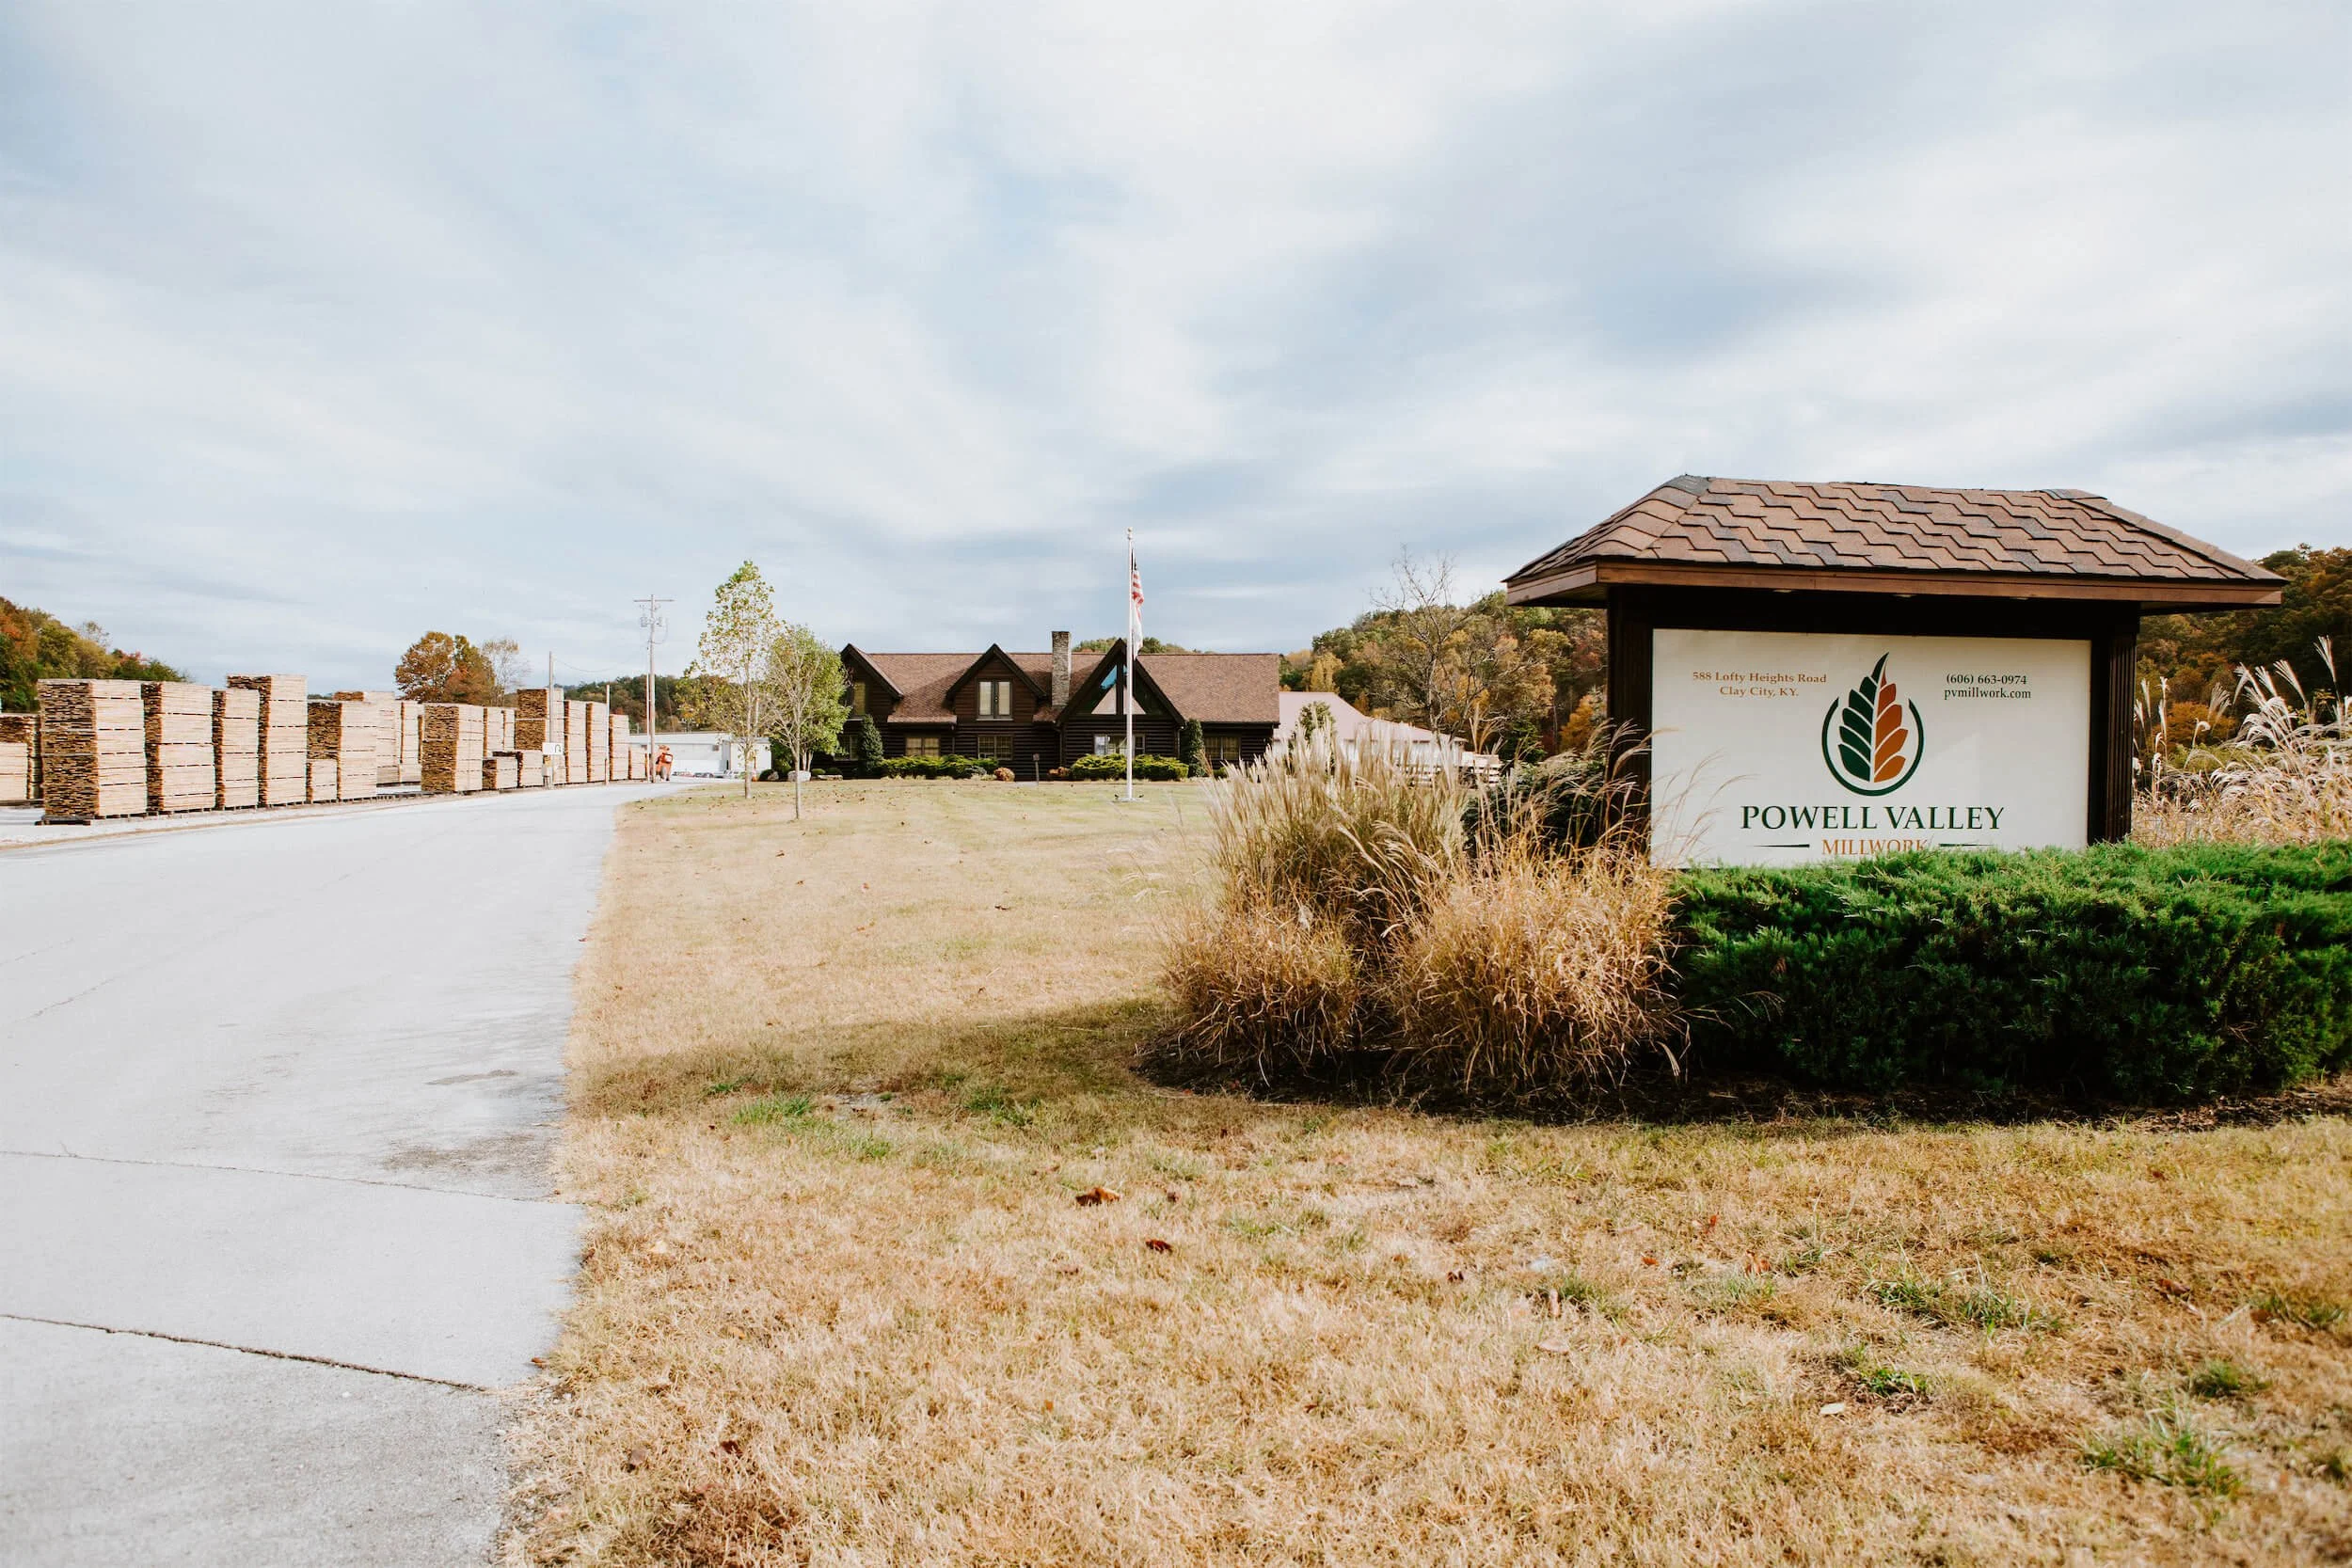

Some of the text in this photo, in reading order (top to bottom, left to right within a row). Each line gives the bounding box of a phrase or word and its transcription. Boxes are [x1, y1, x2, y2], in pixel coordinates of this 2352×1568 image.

[1692, 672, 1827, 684] 588 Lofty Heights Road
[1946, 673, 2027, 685] (606) 663-0974
[1720, 686, 1799, 698] Clay City, KY.
[1944, 687, 2031, 700] pvmillwork.com
[1740, 805, 2005, 830] POWELL VALLEY
[1821, 839, 1928, 856] MILLWORK
